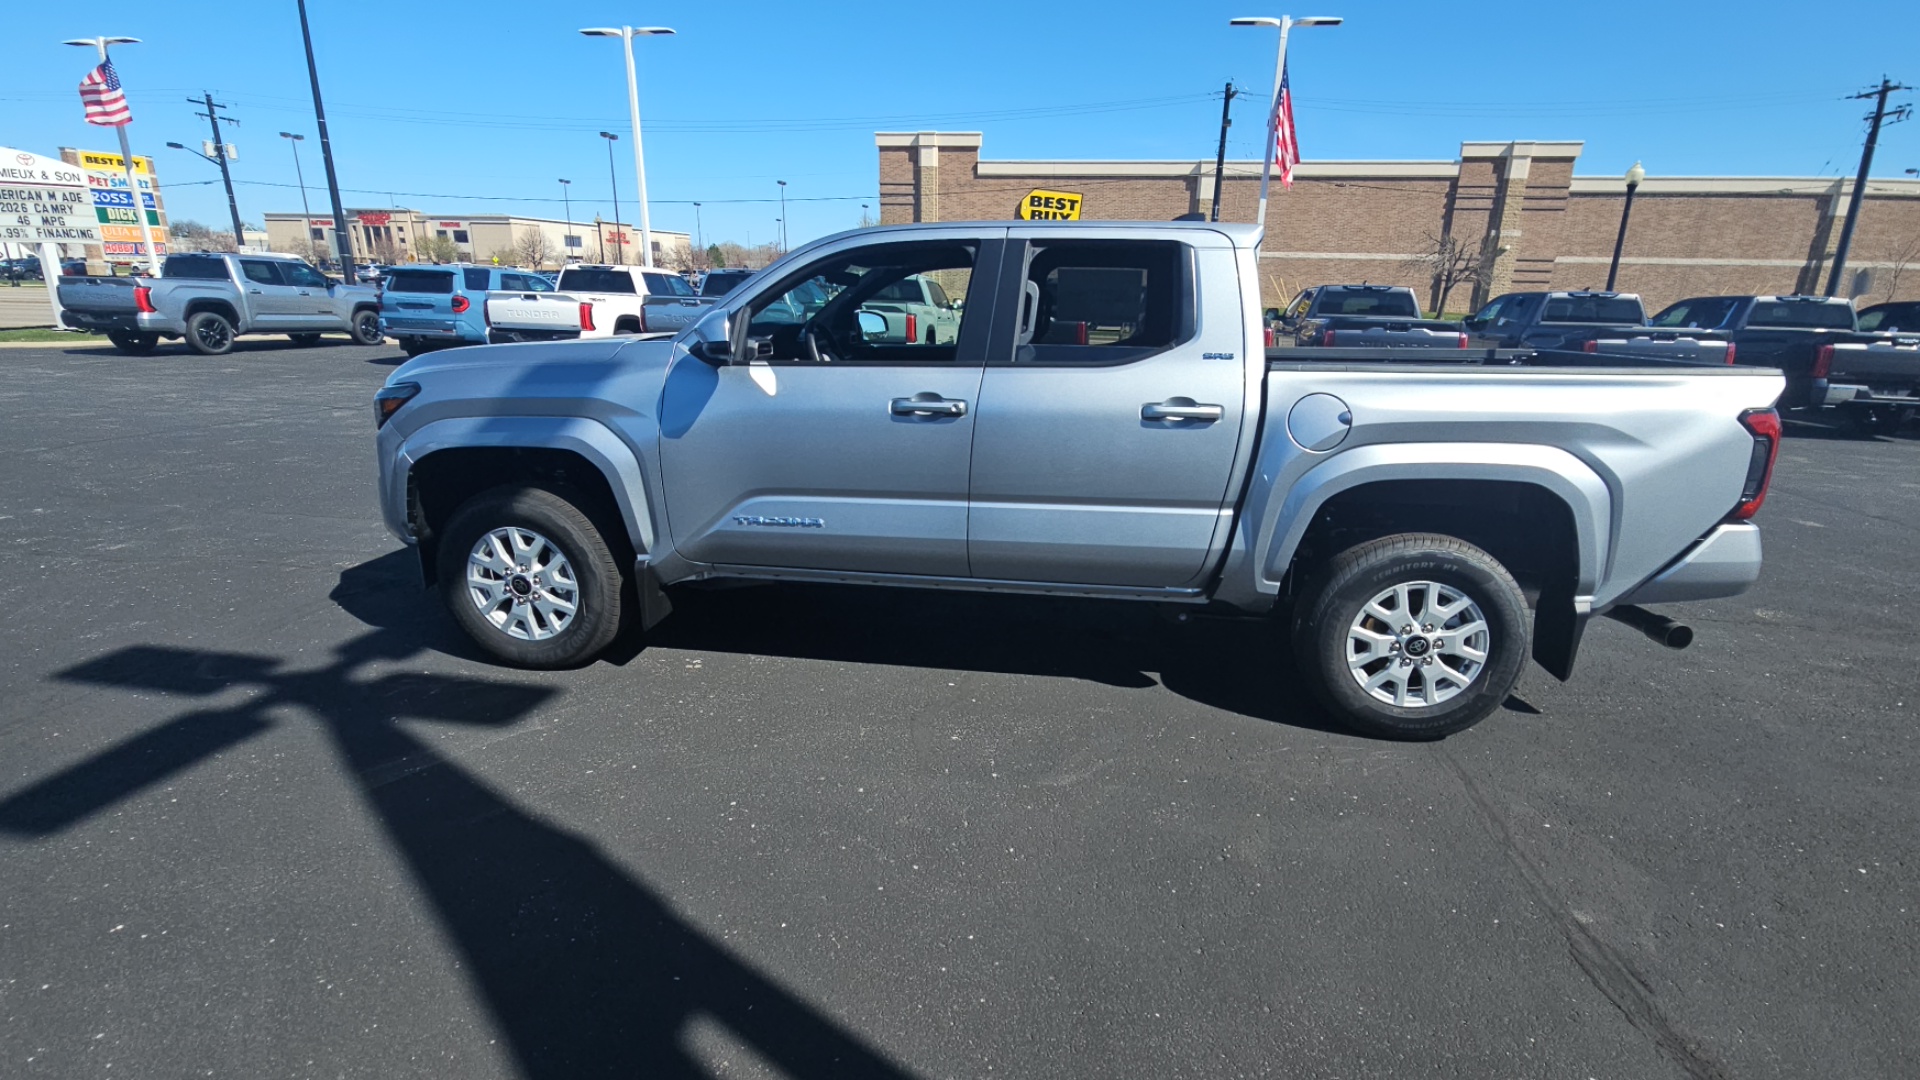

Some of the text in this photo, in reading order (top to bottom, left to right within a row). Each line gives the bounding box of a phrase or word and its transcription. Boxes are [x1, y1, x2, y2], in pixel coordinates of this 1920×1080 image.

[85, 156, 141, 168] BEST BY
[41, 170, 49, 180] &
[54, 171, 81, 182] SON
[87, 174, 149, 189] PETSMRT
[0, 202, 74, 214] 2026 CAMRY
[1030, 196, 1079, 211] BEST
[17, 215, 66, 226] 46 MPG
[107, 208, 137, 221] DICK
[1030, 210, 1072, 220] BUY
[36, 228, 94, 239] FINANCING
[103, 226, 162, 238] ULTA BETY
[105, 243, 164, 254] HOBBY LOBY
[506, 309, 560, 319] TUNDRA
[1372, 561, 1436, 582] TERRITORY
